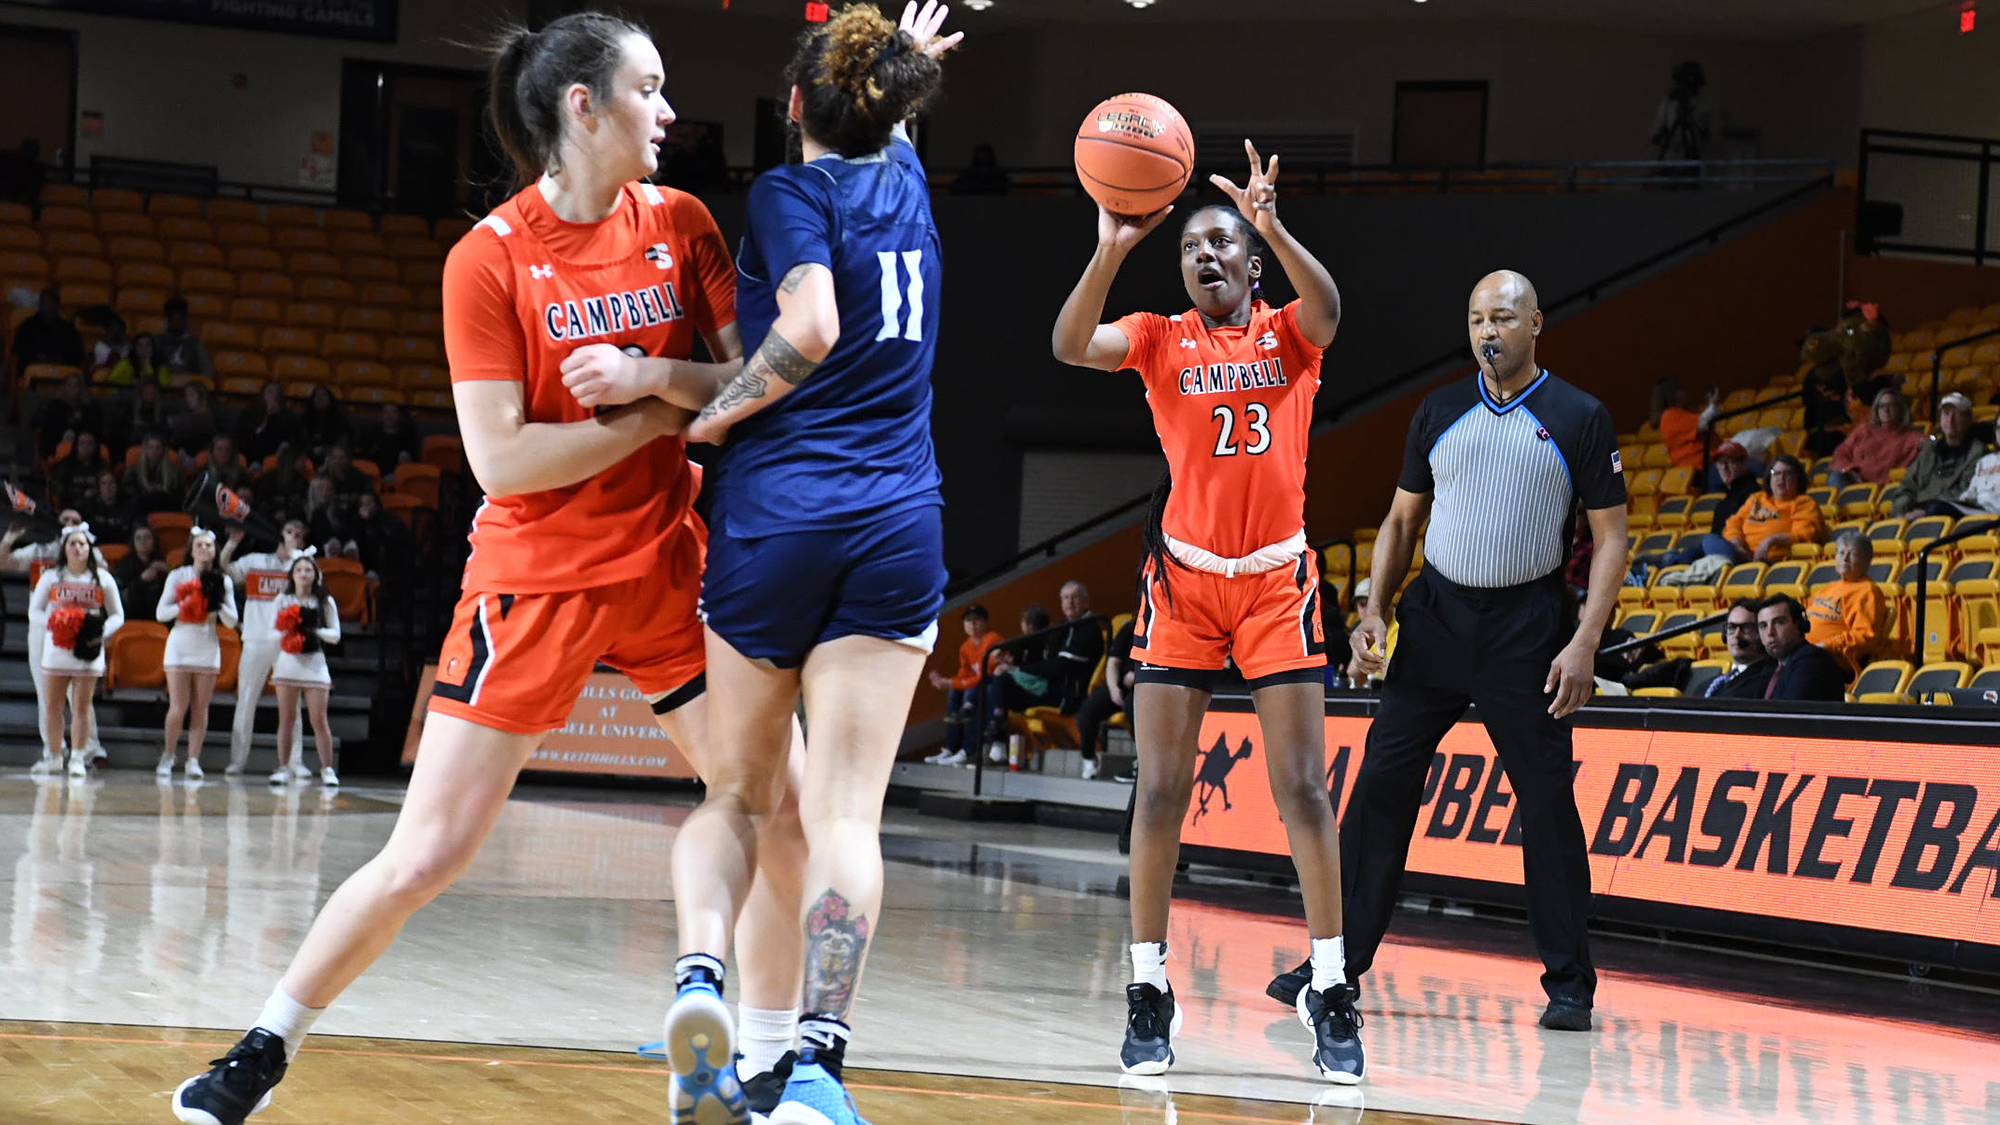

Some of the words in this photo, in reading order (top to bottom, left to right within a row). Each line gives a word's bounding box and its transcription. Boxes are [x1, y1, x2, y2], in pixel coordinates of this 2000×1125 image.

[302, 6, 375, 27] CAMELS
[875, 249, 924, 342] 11
[545, 282, 684, 341] CAMPBELL
[1178, 357, 1288, 395] CAMPBELL
[1210, 402, 1272, 457] 23
[580, 685, 617, 700] ILLS
[599, 705, 619, 719] AT
[601, 725, 669, 740] UNIVERS
